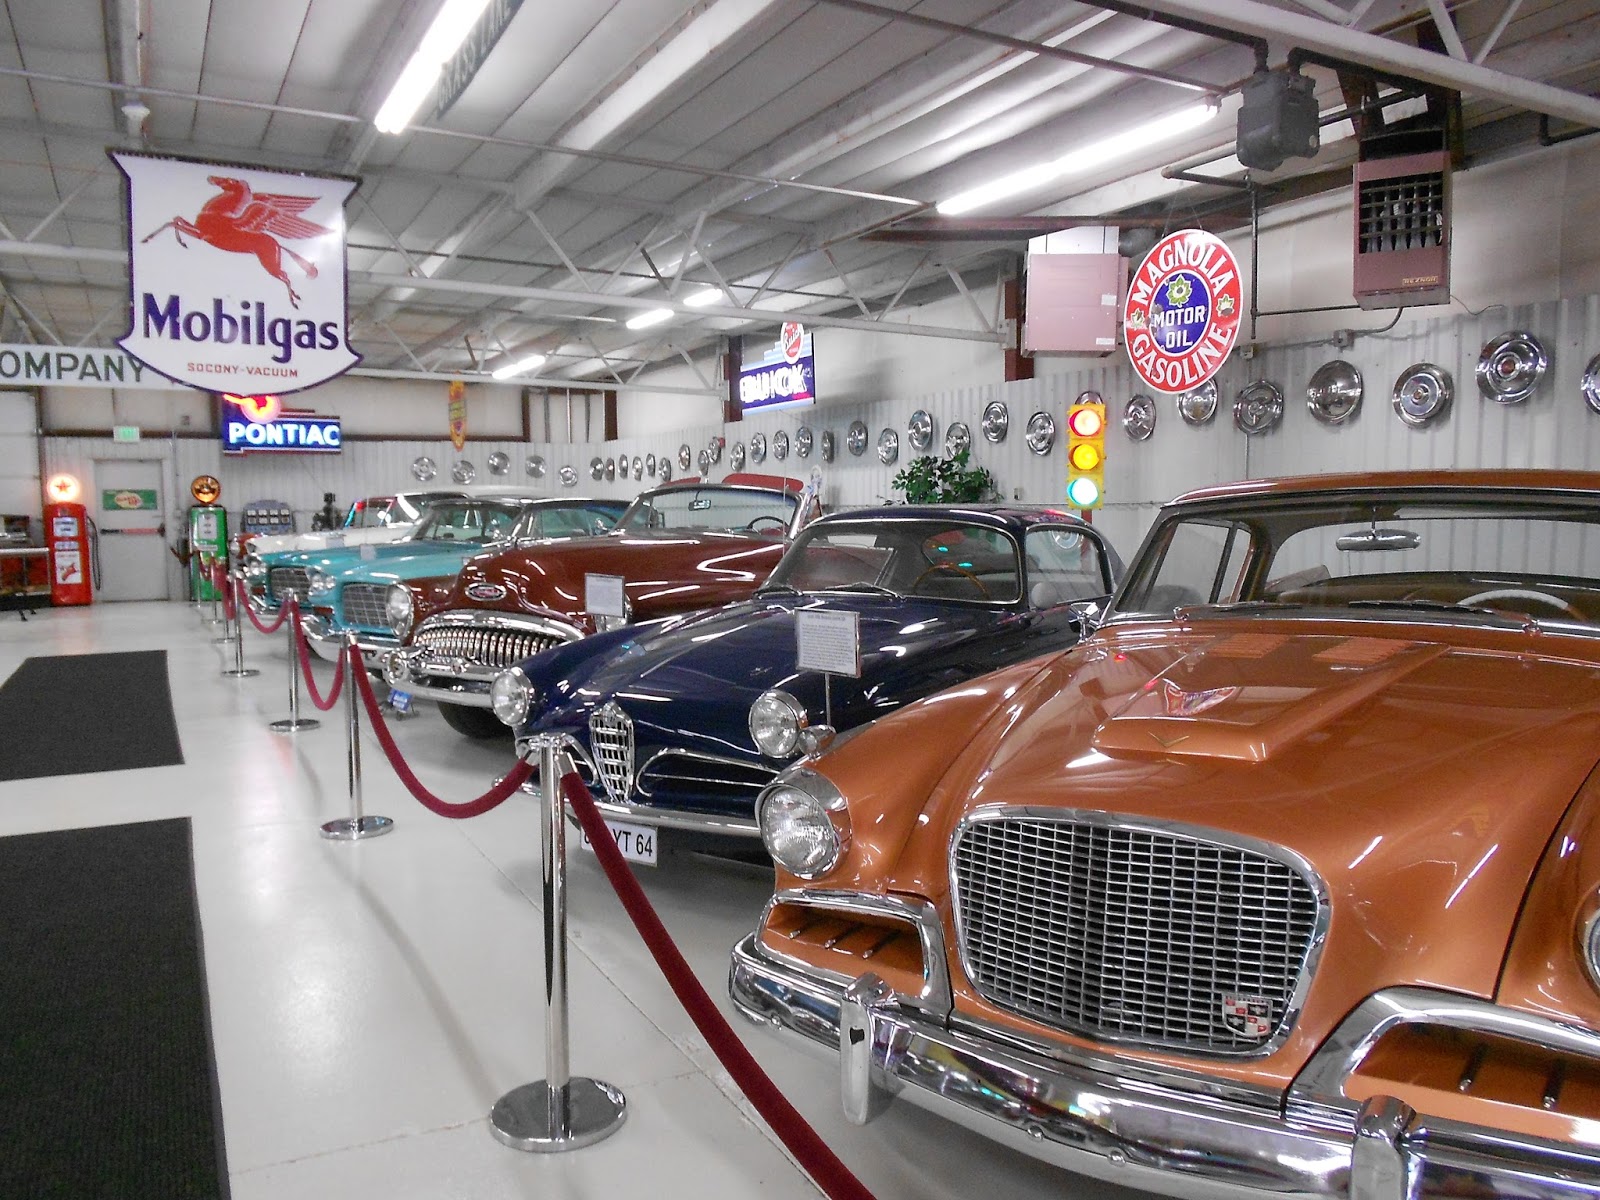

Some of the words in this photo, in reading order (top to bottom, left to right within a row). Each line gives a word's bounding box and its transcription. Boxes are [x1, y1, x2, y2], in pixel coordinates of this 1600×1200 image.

[1132, 238, 1234, 306] MAGNOLIA
[1154, 305, 1205, 327] MOTOR
[142, 293, 339, 364] Mobilgas
[1166, 329, 1194, 349] OIL
[1133, 322, 1232, 388] GASOLINE
[187, 363, 298, 377] SOCONY-VACUUM
[740, 363, 808, 403] BUICK
[228, 422, 340, 446] PONTIAC
[636, 833, 653, 857] 64
